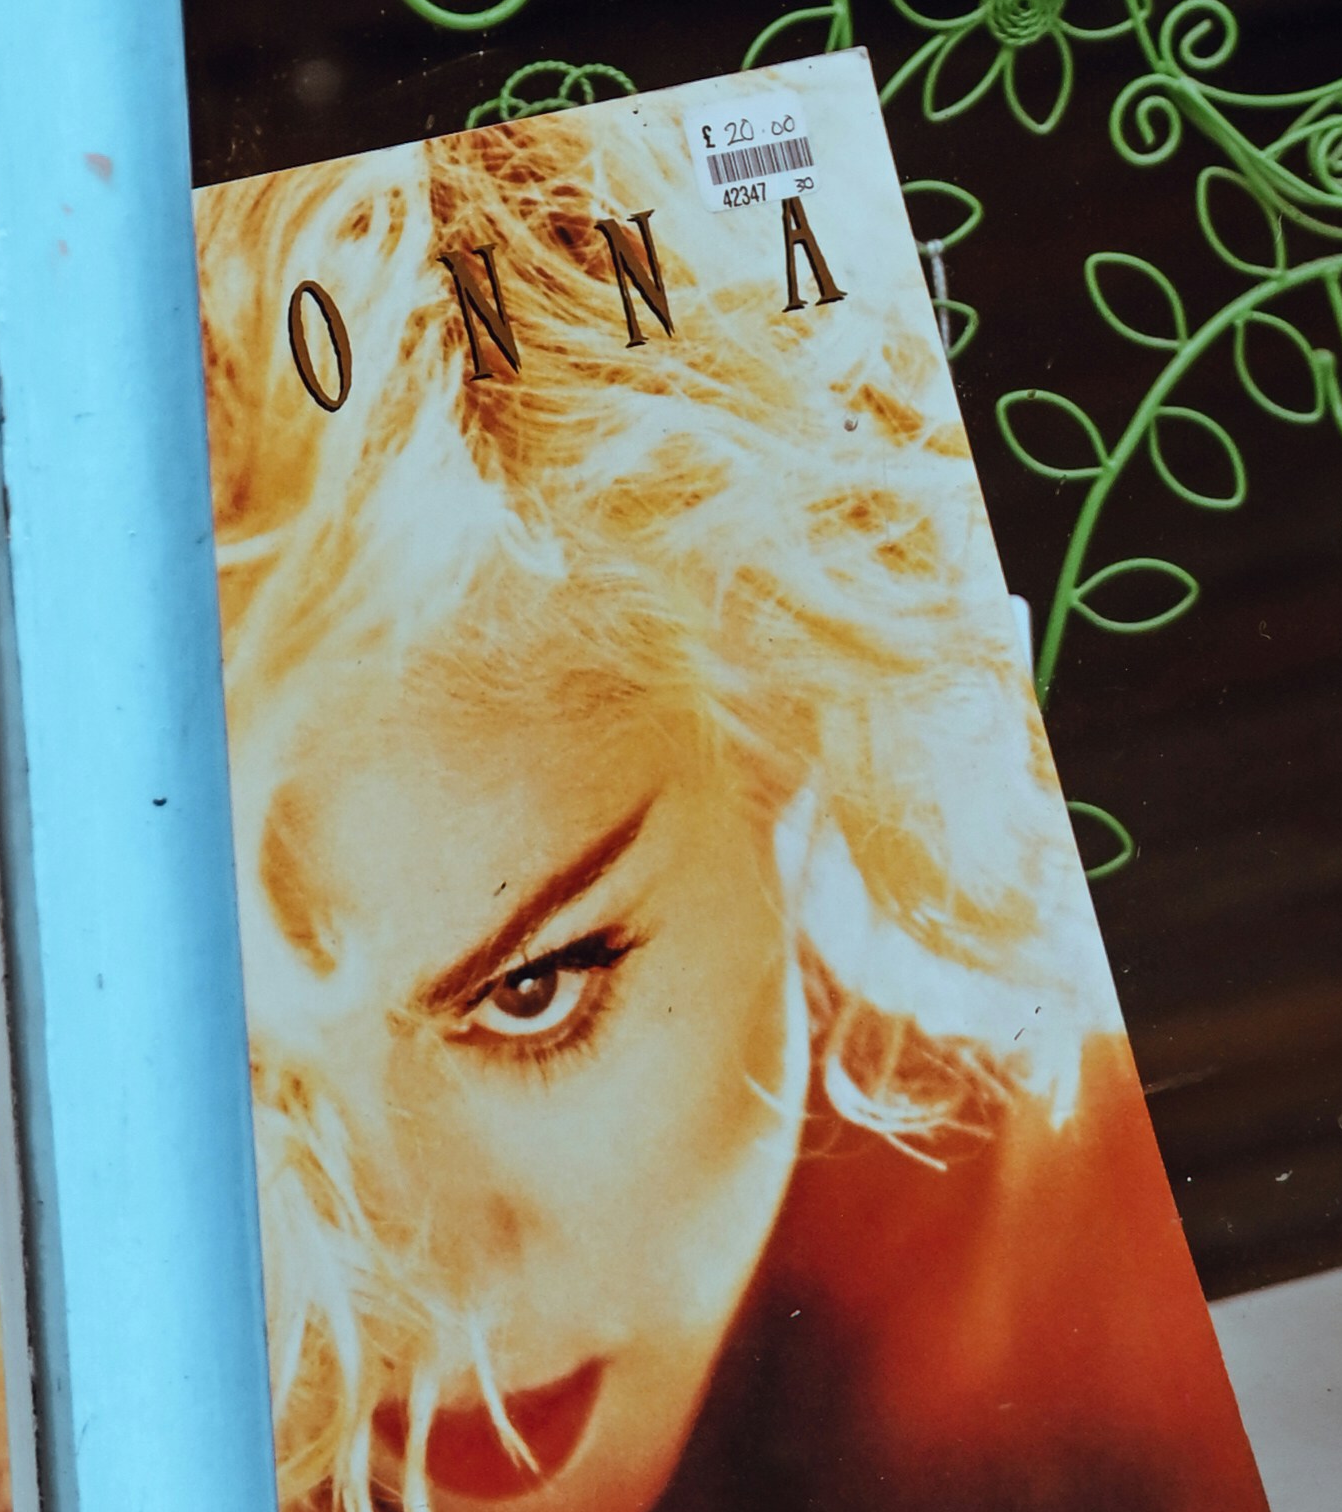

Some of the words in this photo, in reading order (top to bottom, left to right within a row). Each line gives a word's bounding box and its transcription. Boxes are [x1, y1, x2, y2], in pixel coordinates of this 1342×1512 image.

[701, 124, 716, 149] £
[722, 181, 767, 209] 42347
[793, 176, 815, 193] 30
